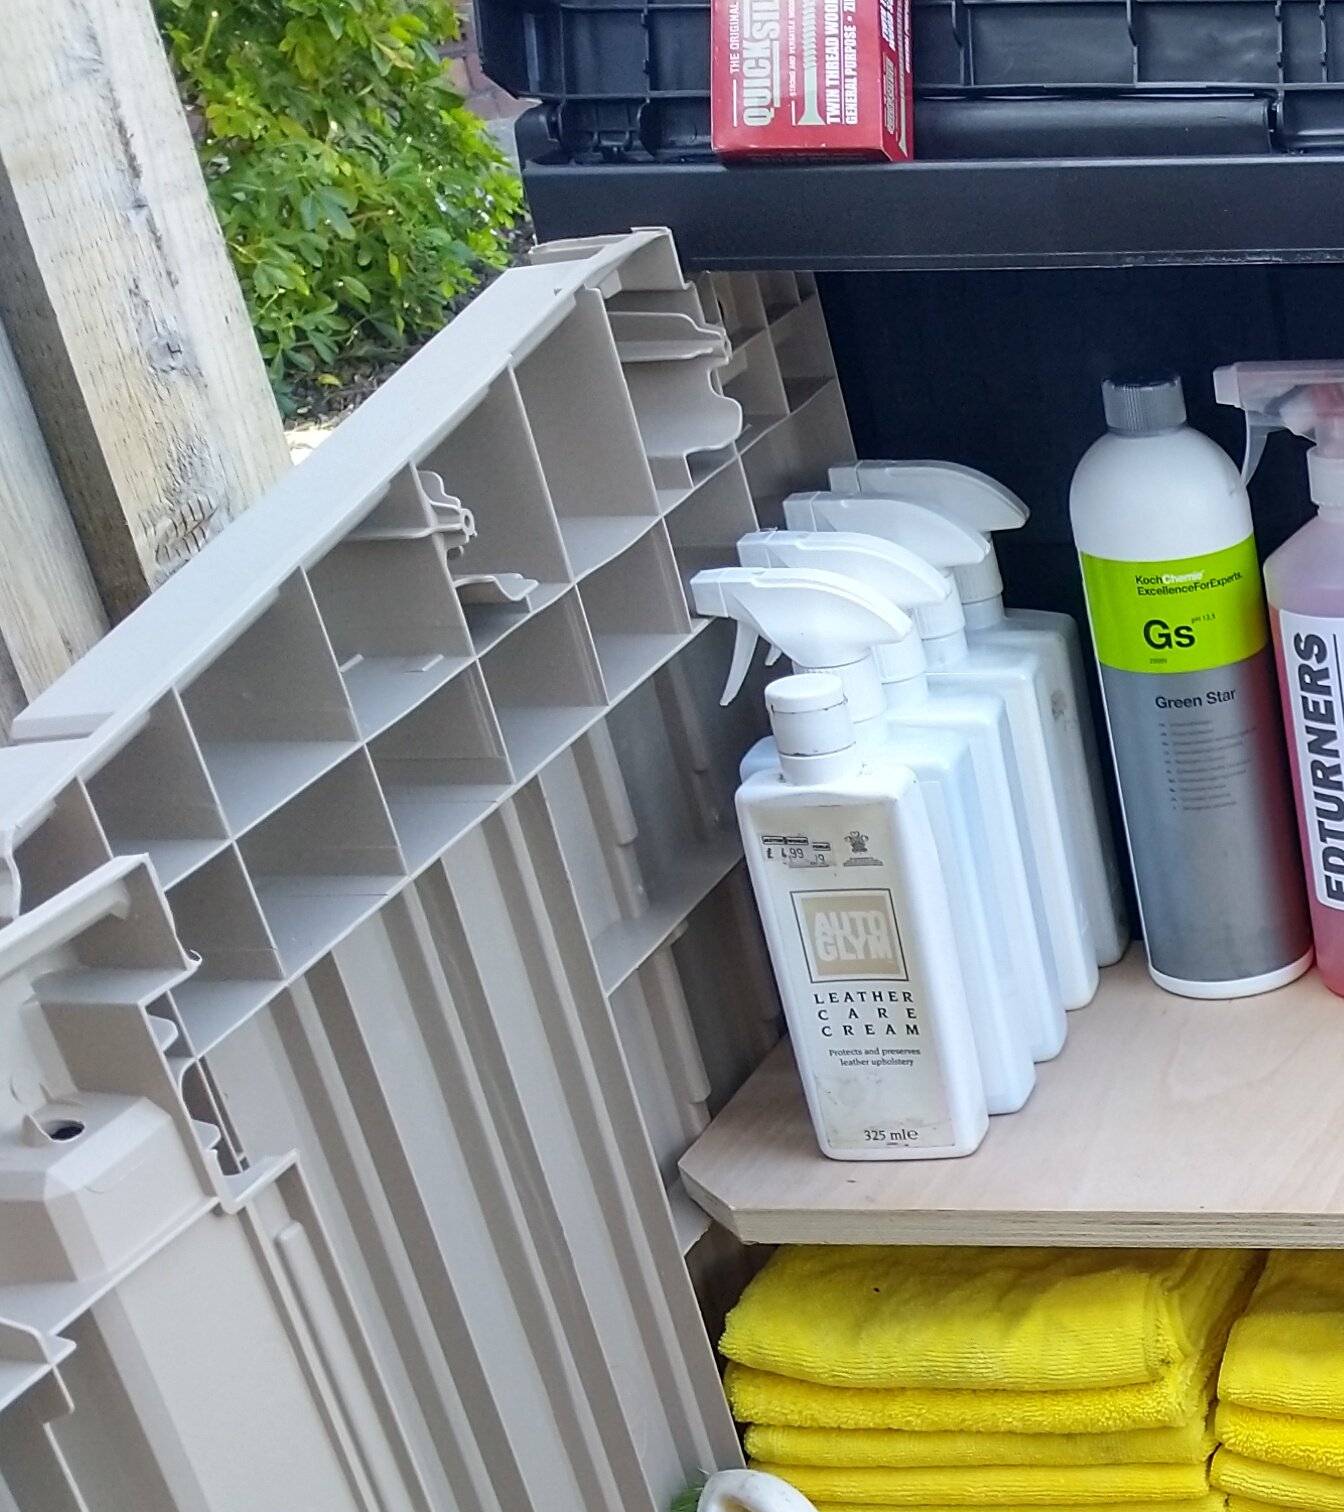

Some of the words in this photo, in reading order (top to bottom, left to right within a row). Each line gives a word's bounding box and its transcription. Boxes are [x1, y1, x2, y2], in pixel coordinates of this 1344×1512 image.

[729, 1, 740, 50] ORIGINAL
[787, 20, 797, 54] VERSATILE
[729, 53, 740, 74] THE
[788, 56, 797, 70] AND
[825, 38, 840, 86] THREAD
[843, 25, 858, 76] PURPOSE
[788, 71, 797, 97] STRONG
[826, 89, 841, 125] TWIN
[844, 77, 859, 125] GENERAL
[1143, 619, 1195, 650] Gs
[1155, 694, 1203, 709] Green
[1207, 688, 1236, 706] Star
[815, 910, 887, 937] AUTO
[816, 933, 893, 962] GLYM
[813, 991, 914, 1005] LEATHER
[818, 1007, 917, 1021] CARE
[821, 1023, 921, 1038] CREAM
[829, 1048, 863, 1057] Protects
[864, 1047, 881, 1056] and
[882, 1048, 921, 1058] preserves
[841, 1057, 869, 1066] leather
[871, 1057, 914, 1067] upholstery
[864, 1129, 886, 1142] 325
